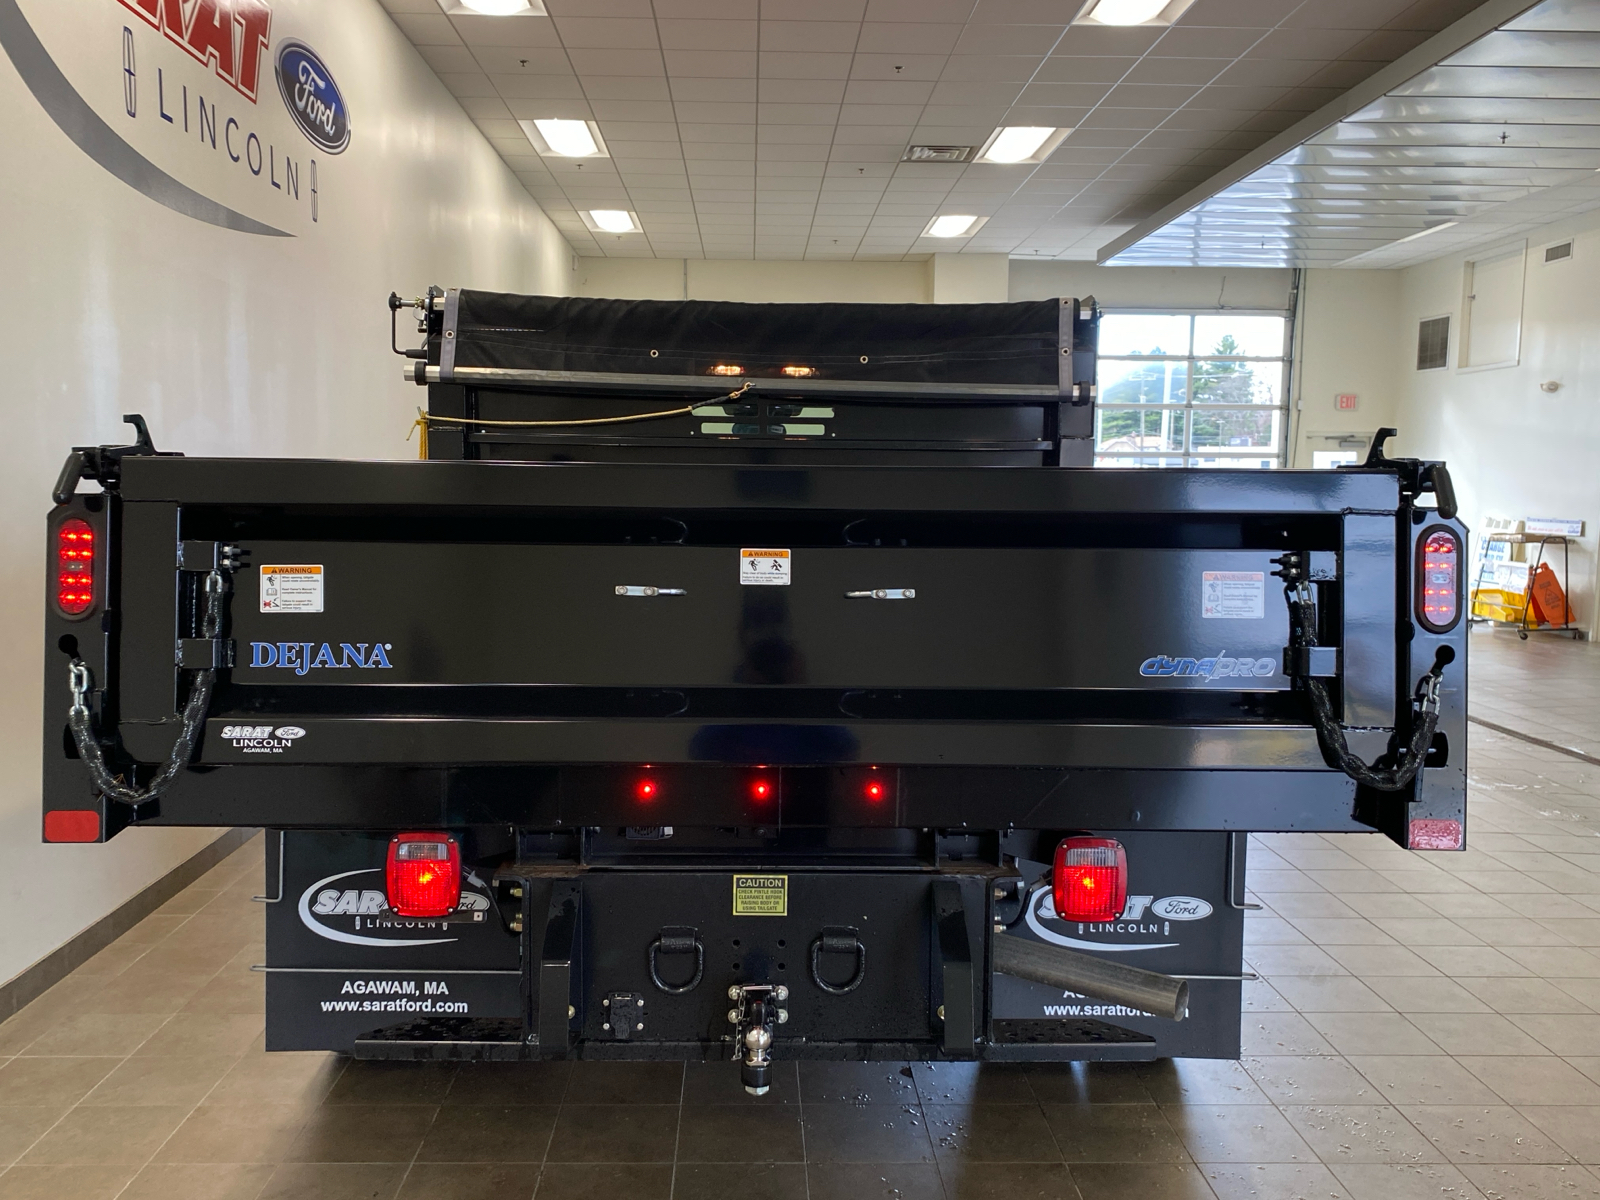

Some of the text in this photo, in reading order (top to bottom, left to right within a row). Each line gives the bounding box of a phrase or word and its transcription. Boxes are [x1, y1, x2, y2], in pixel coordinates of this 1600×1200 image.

[294, 60, 336, 137] Ford
[157, 67, 299, 201] LINCOLN
[1340, 394, 1357, 409] EXIT
[221, 725, 274, 739] SARAT
[232, 739, 292, 747] LINCOLN
[739, 879, 781, 887] CAUTION
[1164, 900, 1199, 915] Ford
[1089, 923, 1158, 933] LINCOLN
[341, 981, 449, 996] AGAWAM, MA
[321, 999, 468, 1013] www.saratford.com
